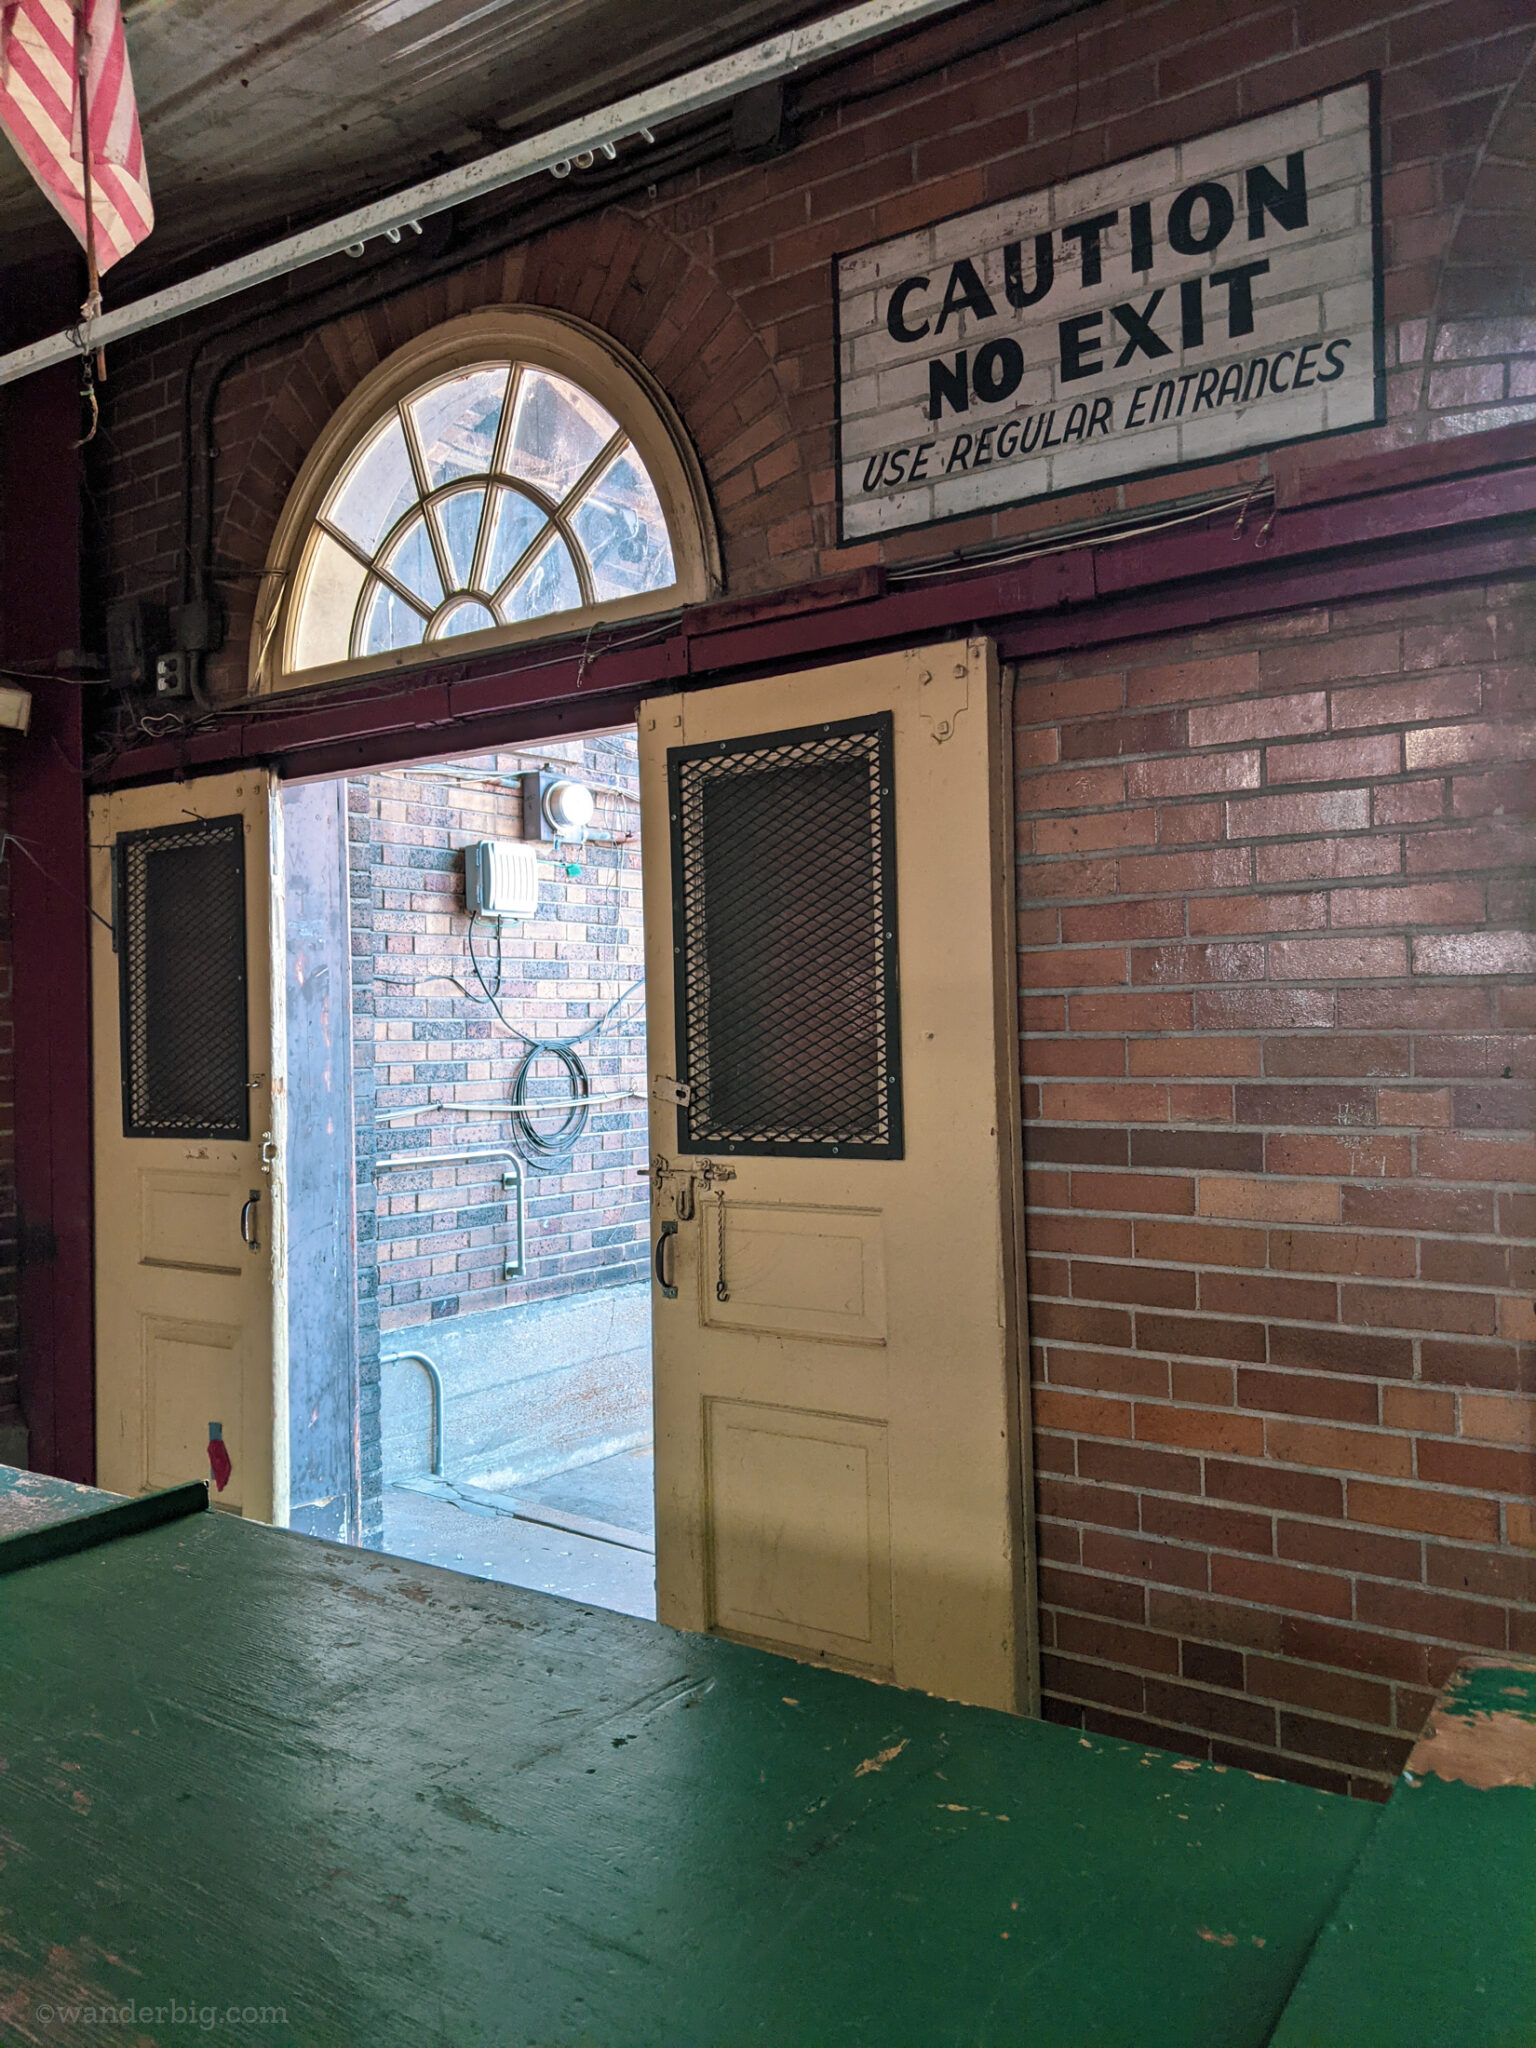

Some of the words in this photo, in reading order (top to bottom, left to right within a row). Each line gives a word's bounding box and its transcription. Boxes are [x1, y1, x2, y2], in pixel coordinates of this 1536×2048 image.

[887, 151, 1309, 343] CAUTION
[863, 442, 935, 492] USE
[946, 397, 1112, 474] REGULAR
[1125, 338, 1352, 429] ENTRANCES
[928, 337, 1024, 421] NO
[1058, 259, 1270, 382] EXIT
